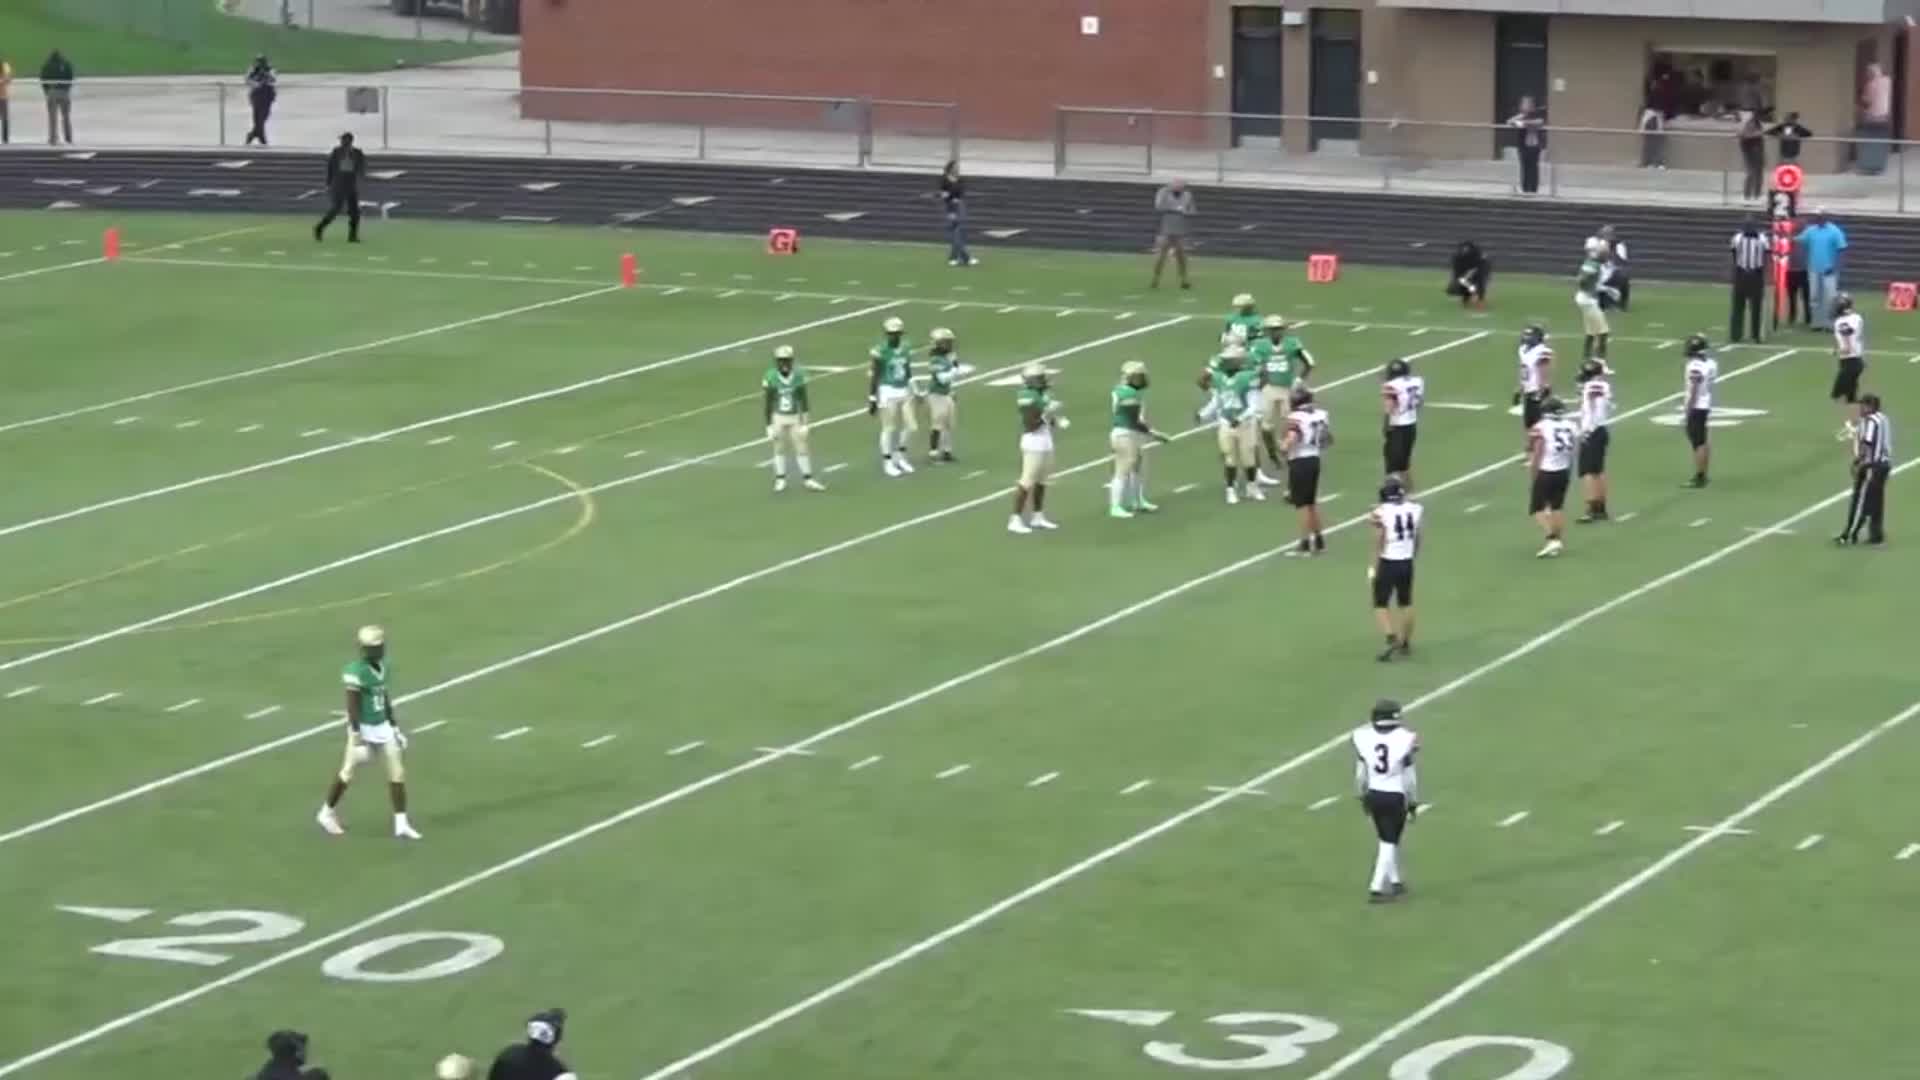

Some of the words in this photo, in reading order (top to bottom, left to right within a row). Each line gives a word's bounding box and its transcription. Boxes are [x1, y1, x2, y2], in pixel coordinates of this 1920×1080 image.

[1773, 192, 1791, 217] 2
[771, 231, 790, 252] G
[1394, 512, 1415, 541] 44
[1374, 743, 1389, 774] 3
[87, 909, 504, 982] 20
[1142, 1011, 1574, 1080] 30
